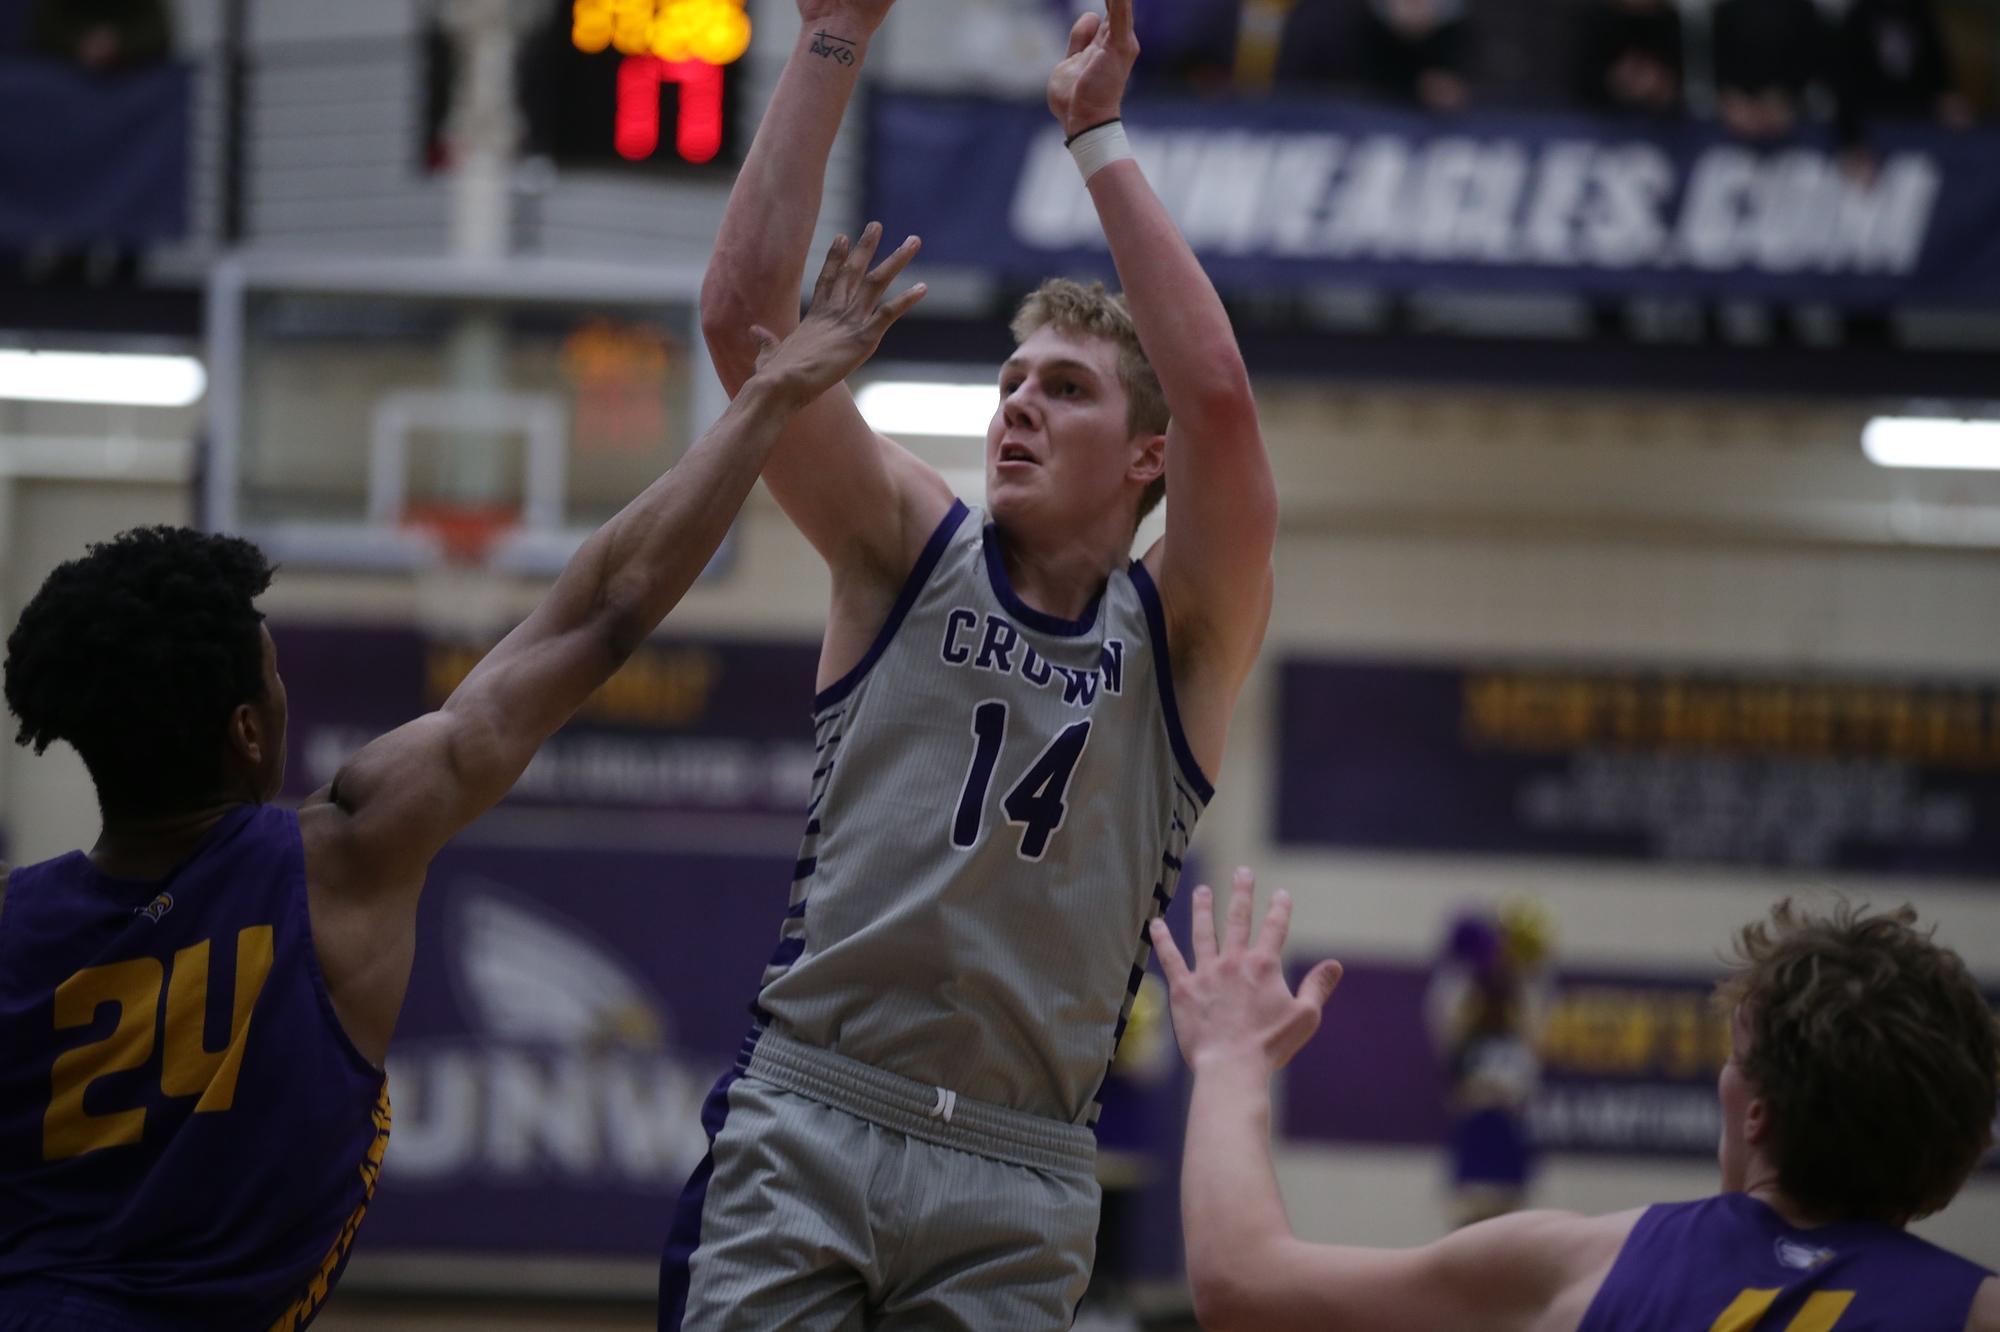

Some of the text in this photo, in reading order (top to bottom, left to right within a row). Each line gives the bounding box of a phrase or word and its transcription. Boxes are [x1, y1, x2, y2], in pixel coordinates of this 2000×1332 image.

[940, 607, 1124, 706] CROWN
[949, 698, 1093, 862] 14
[42, 924, 274, 1161] 24
